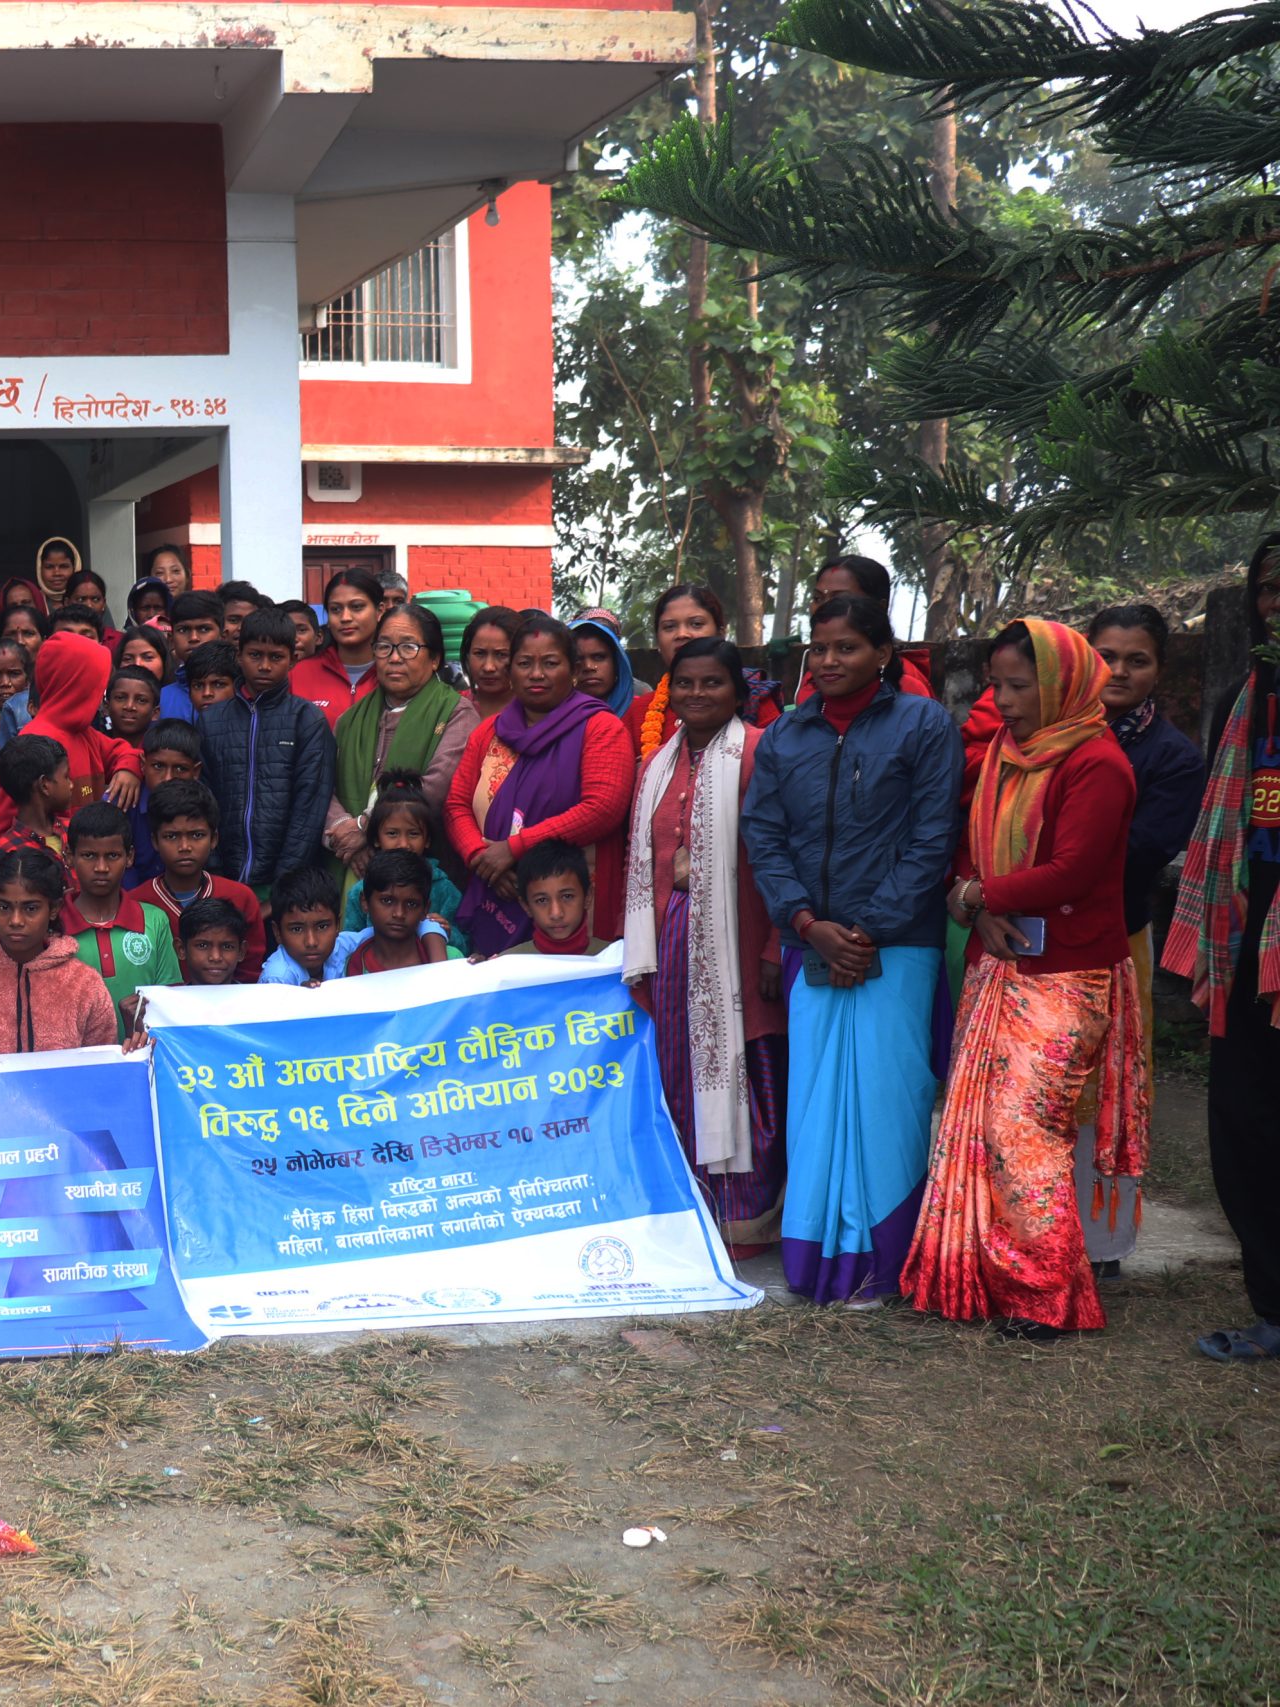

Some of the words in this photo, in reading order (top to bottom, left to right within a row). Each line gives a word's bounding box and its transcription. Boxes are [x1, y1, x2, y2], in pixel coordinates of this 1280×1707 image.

[177, 1065, 217, 1093] ३२
[456, 1023, 556, 1069] लैङ्गिक
[565, 1010, 635, 1046] हिंसा
[288, 1105, 329, 1132] १६
[337, 1090, 397, 1127] दिने
[406, 1075, 538, 1119] अभियान
[548, 1062, 625, 1095] २०२३
[24, 1143, 59, 1165] प्रहरी
[251, 1158, 277, 1177] २५
[371, 1140, 413, 1166] देखि
[420, 1130, 502, 1159] डिसेम्बर
[507, 1126, 533, 1144] १०
[540, 1116, 591, 1141] सम्म
[64, 1180, 117, 1200] स्थानीय
[122, 1181, 142, 1197] तह
[335, 1222, 434, 1249] बालबालिकामा
[440, 1210, 505, 1237] लगानीको
[42, 1262, 108, 1283] सामाजिक
